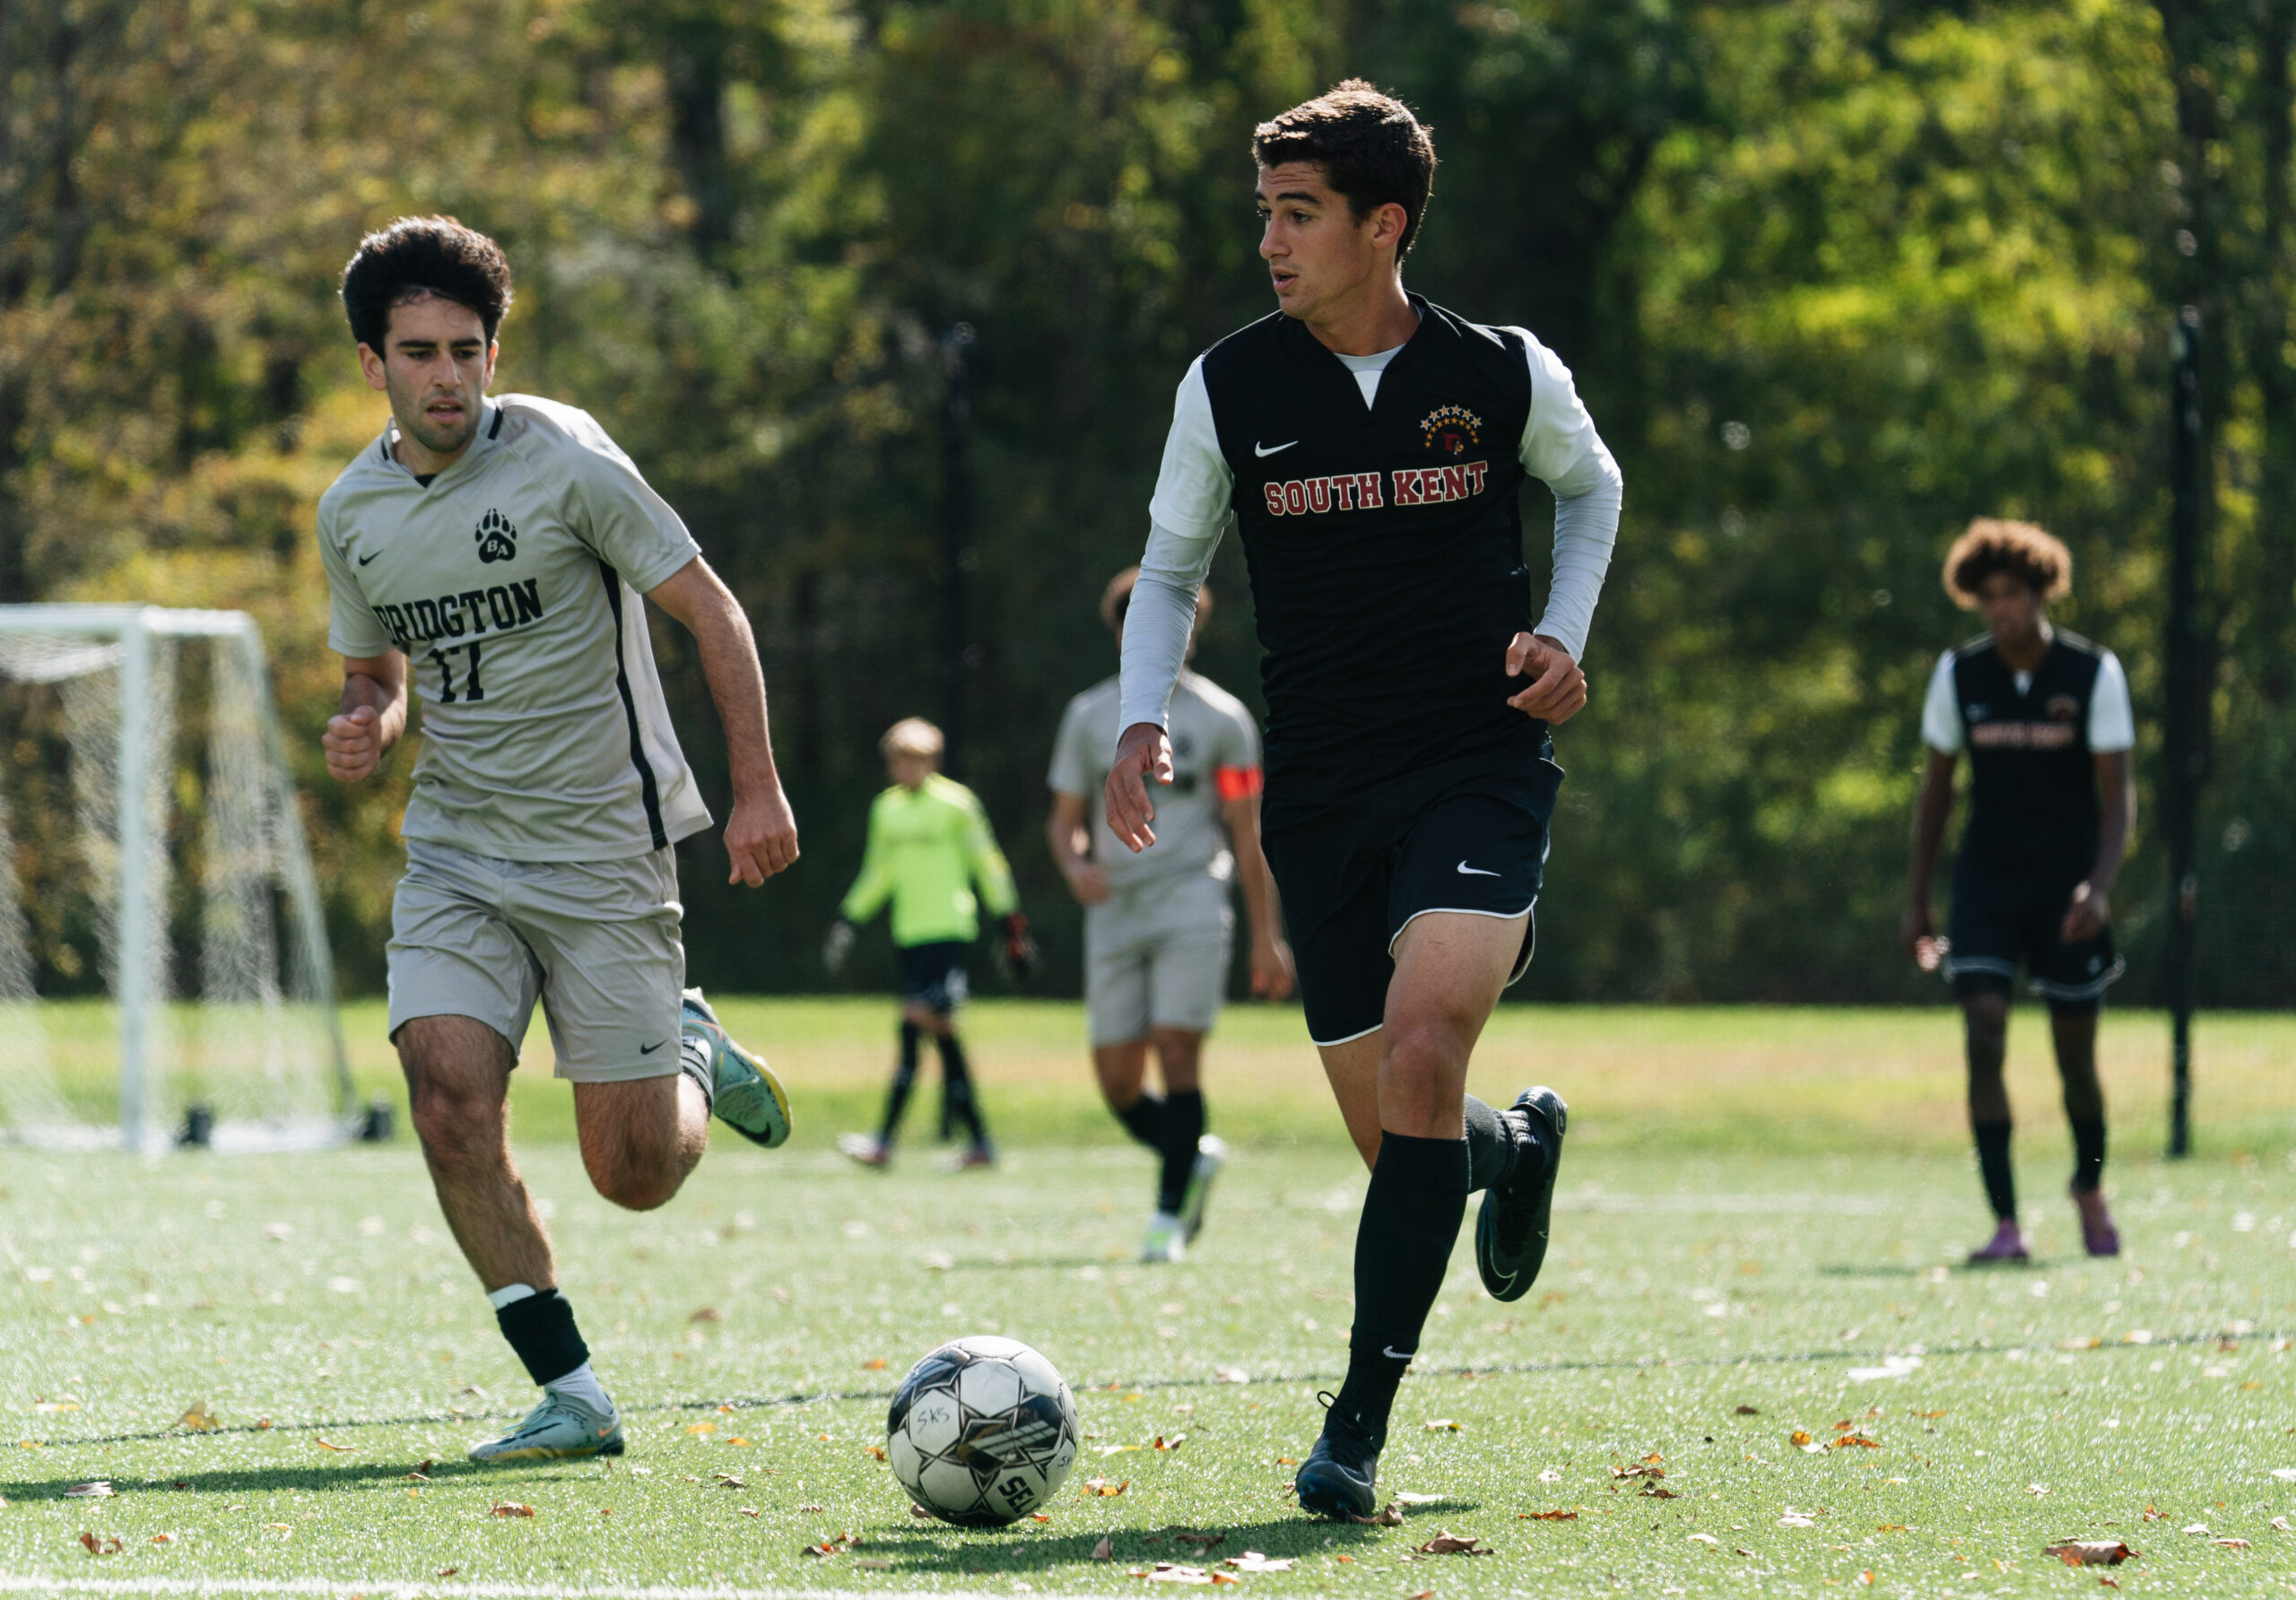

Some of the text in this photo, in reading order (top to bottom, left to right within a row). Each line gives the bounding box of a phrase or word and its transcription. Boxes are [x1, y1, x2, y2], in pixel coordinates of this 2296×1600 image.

[1264, 460, 1488, 516] SOUTH KENT
[487, 539, 509, 557] BA
[428, 640, 484, 703] 17
[917, 1406, 950, 1434] SKS
